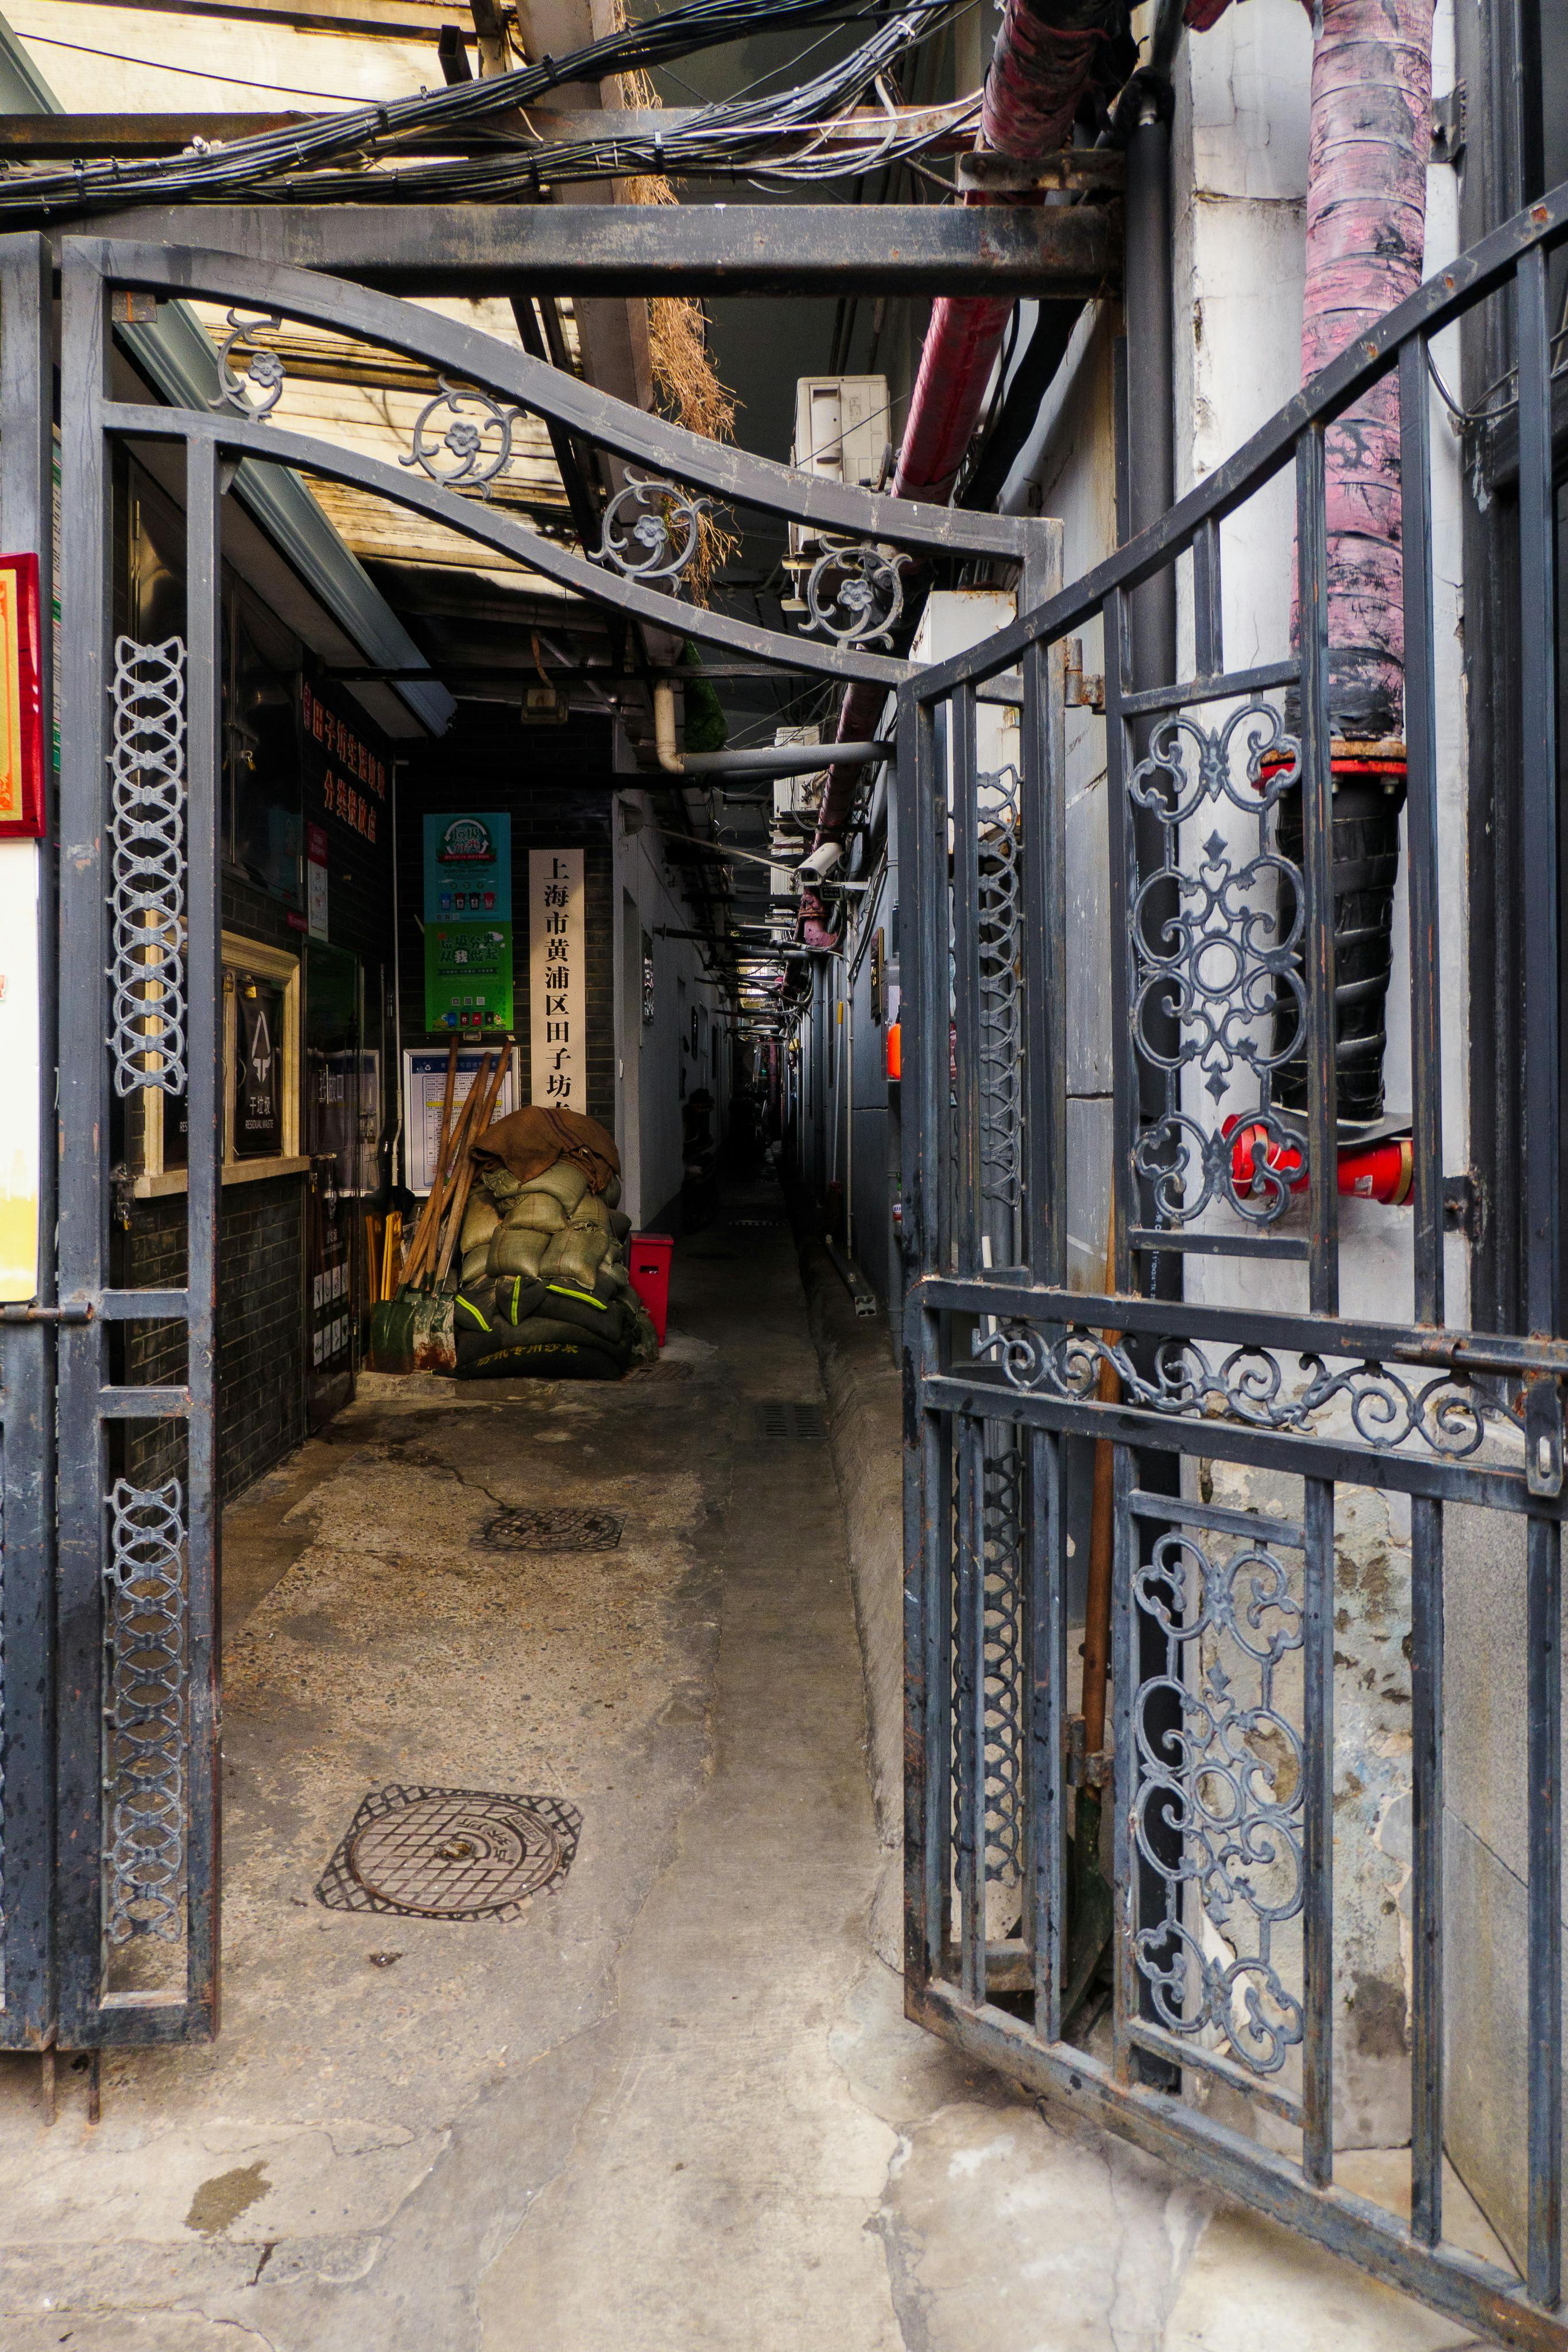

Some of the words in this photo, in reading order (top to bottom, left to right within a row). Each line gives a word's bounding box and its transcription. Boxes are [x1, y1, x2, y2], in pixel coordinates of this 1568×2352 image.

[324, 769, 377, 844] 分类投放点
[440, 934, 497, 949] 垃圾分类
[440, 948, 499, 964] 从我做起
[249, 1095, 270, 1115] 干垃圾
[245, 1120, 262, 1129] RESIDUAL
[262, 1119, 274, 1129] WASTE
